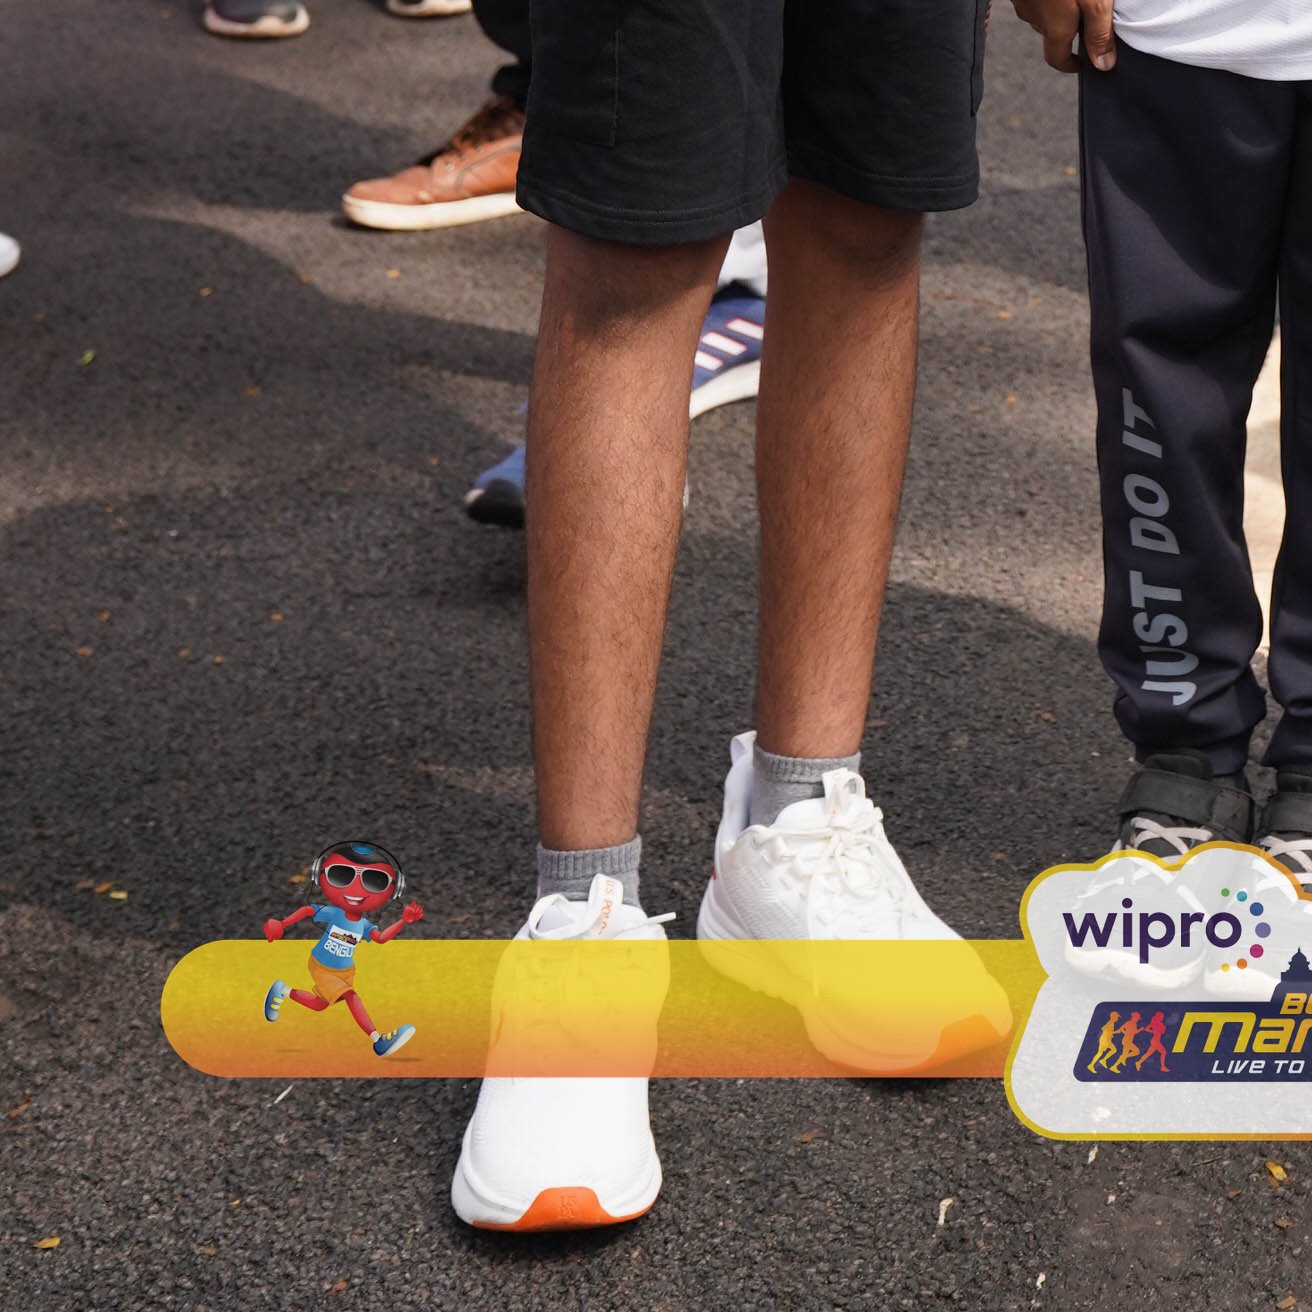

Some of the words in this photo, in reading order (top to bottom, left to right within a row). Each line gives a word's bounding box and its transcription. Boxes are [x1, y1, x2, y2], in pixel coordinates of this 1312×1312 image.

[1122, 387, 1163, 459] IT
[1123, 473, 1181, 555] DO
[1129, 570, 1200, 706] JUST
